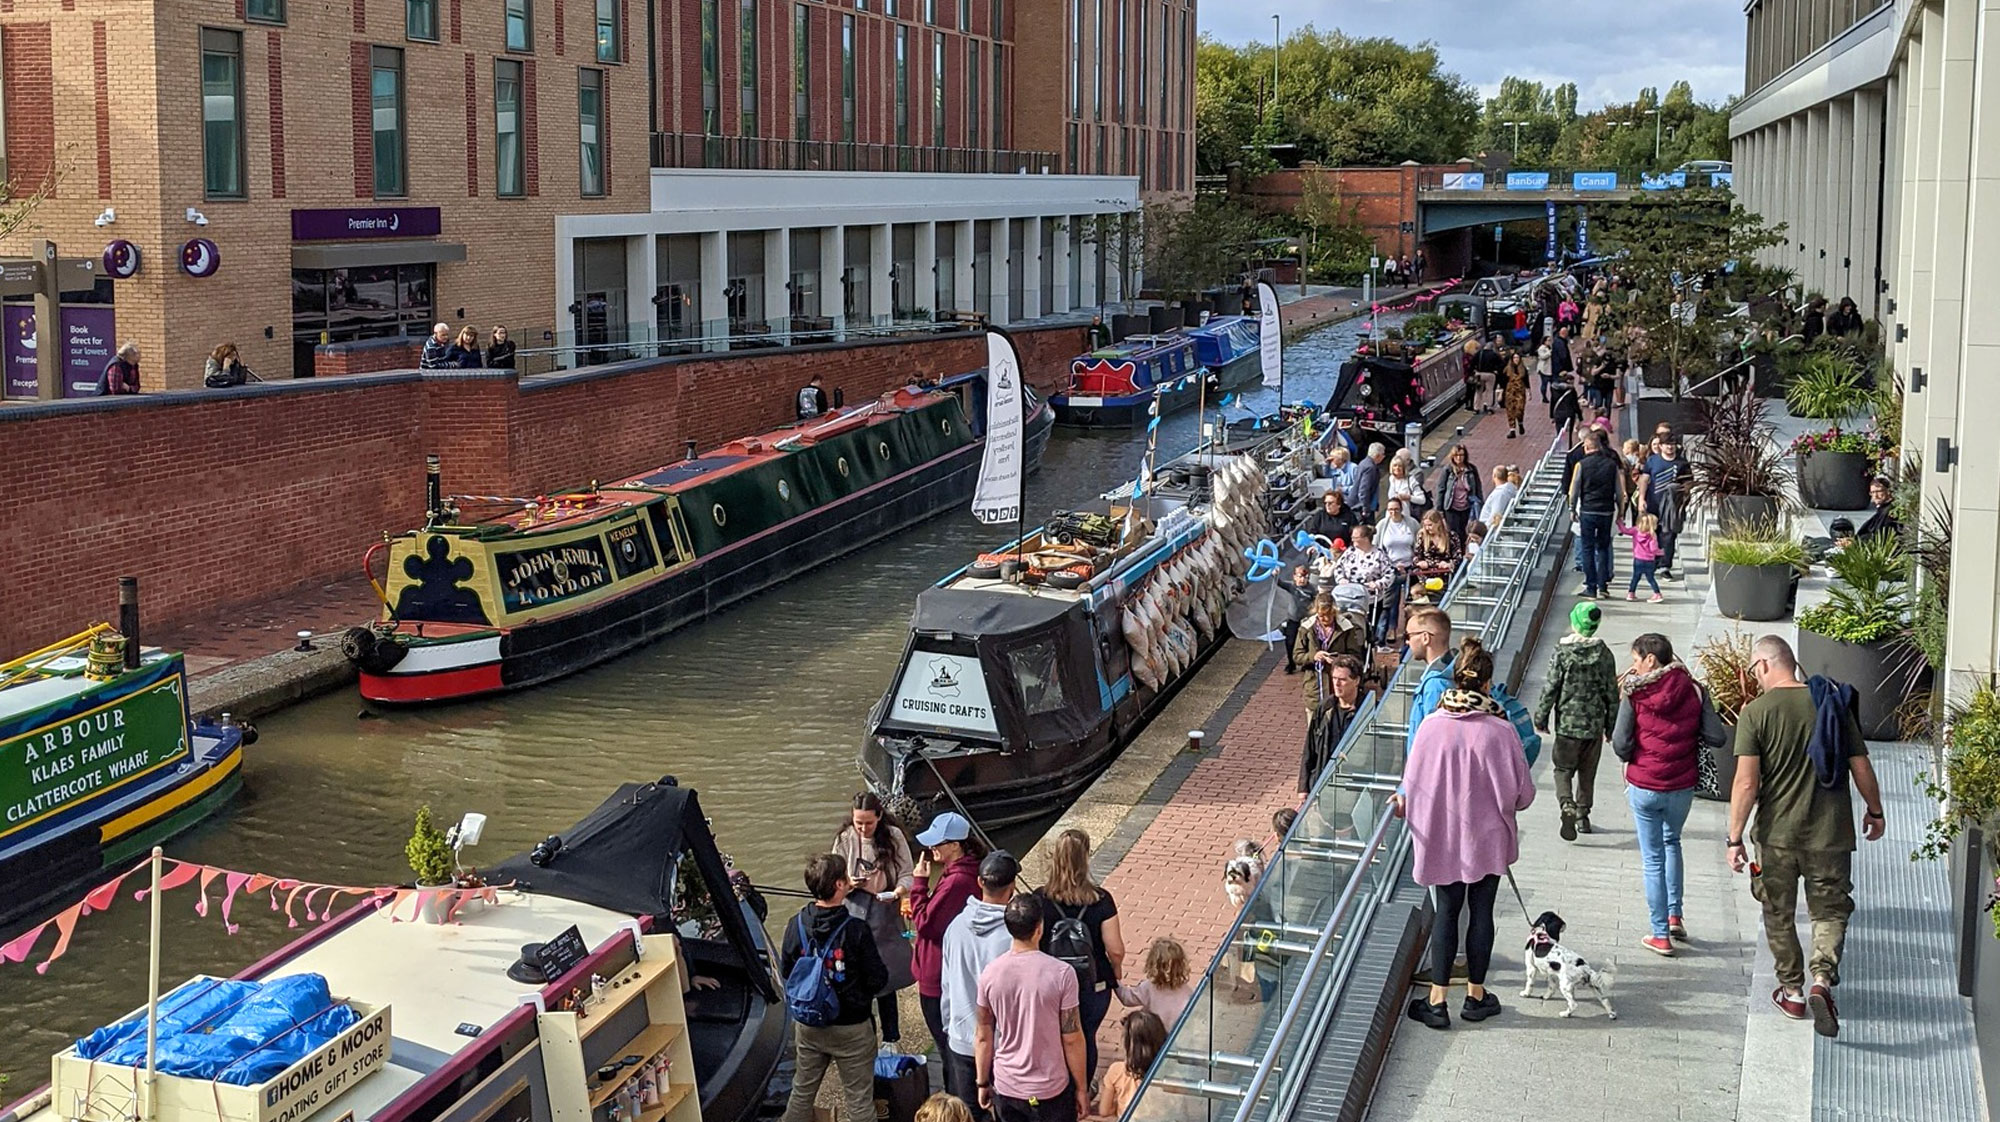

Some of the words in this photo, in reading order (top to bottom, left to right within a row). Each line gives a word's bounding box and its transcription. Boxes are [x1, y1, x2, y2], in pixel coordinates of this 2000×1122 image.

[1581, 177, 1609, 186] Canal
[348, 218, 375, 230] Premier
[376, 218, 388, 229] Inn
[70, 326, 89, 334] Book
[70, 337, 91, 345] direct
[92, 337, 103, 345] for
[84, 348, 108, 356] lowest
[509, 551, 555, 587] JOHN
[519, 571, 603, 605] LONDON
[902, 698, 947, 714] CRUISING
[949, 704, 987, 719] CRAFTS
[25, 709, 125, 764] ARBOUR
[32, 754, 75, 784] KLAES
[81, 733, 126, 764] FAMILY
[7, 770, 102, 822] CLATTERCOTE
[108, 750, 149, 778] WHARF
[280, 1056, 323, 1100] HOME
[328, 1048, 337, 1066] &
[341, 1016, 383, 1058] MOOR
[324, 1069, 347, 1095] GIFT
[352, 1043, 383, 1075] STORE
